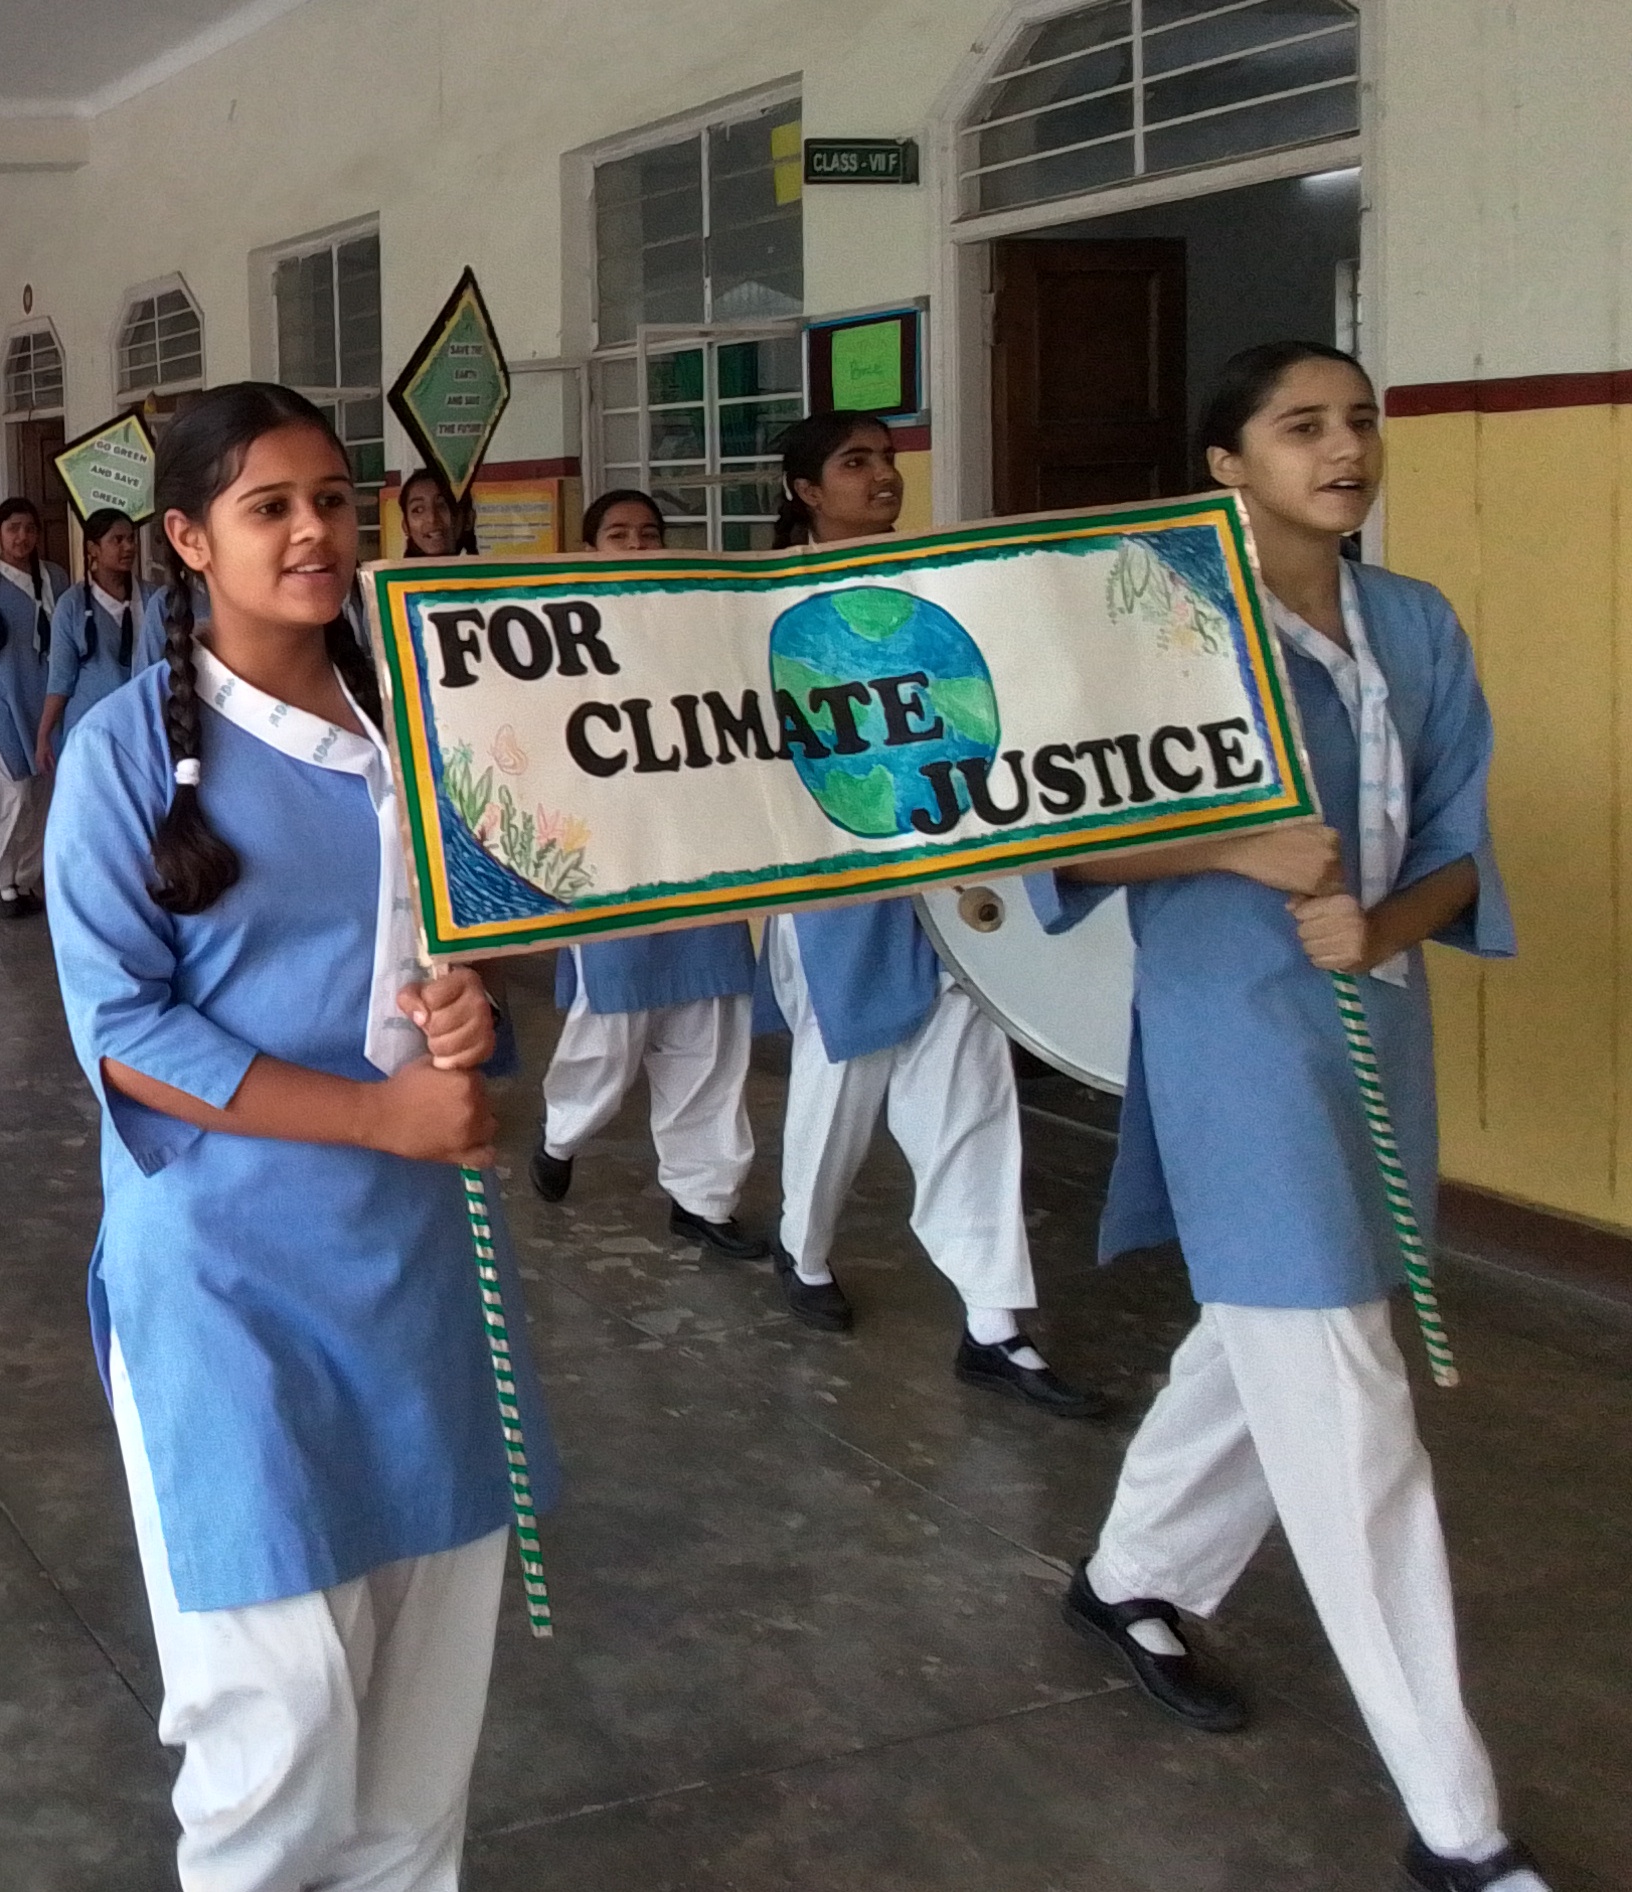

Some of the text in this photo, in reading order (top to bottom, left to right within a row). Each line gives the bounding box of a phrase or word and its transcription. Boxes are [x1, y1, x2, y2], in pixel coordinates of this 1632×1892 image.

[813, 152, 858, 172] CLASS
[888, 153, 898, 173] F
[438, 423, 456, 434] THE
[96, 440, 148, 464] GO GREEN
[90, 464, 140, 487] AND SAVE
[91, 490, 126, 508] GREEN
[428, 600, 620, 688] FOR
[566, 671, 944, 778] CLIMATE
[910, 716, 1263, 835] JUSTICE
